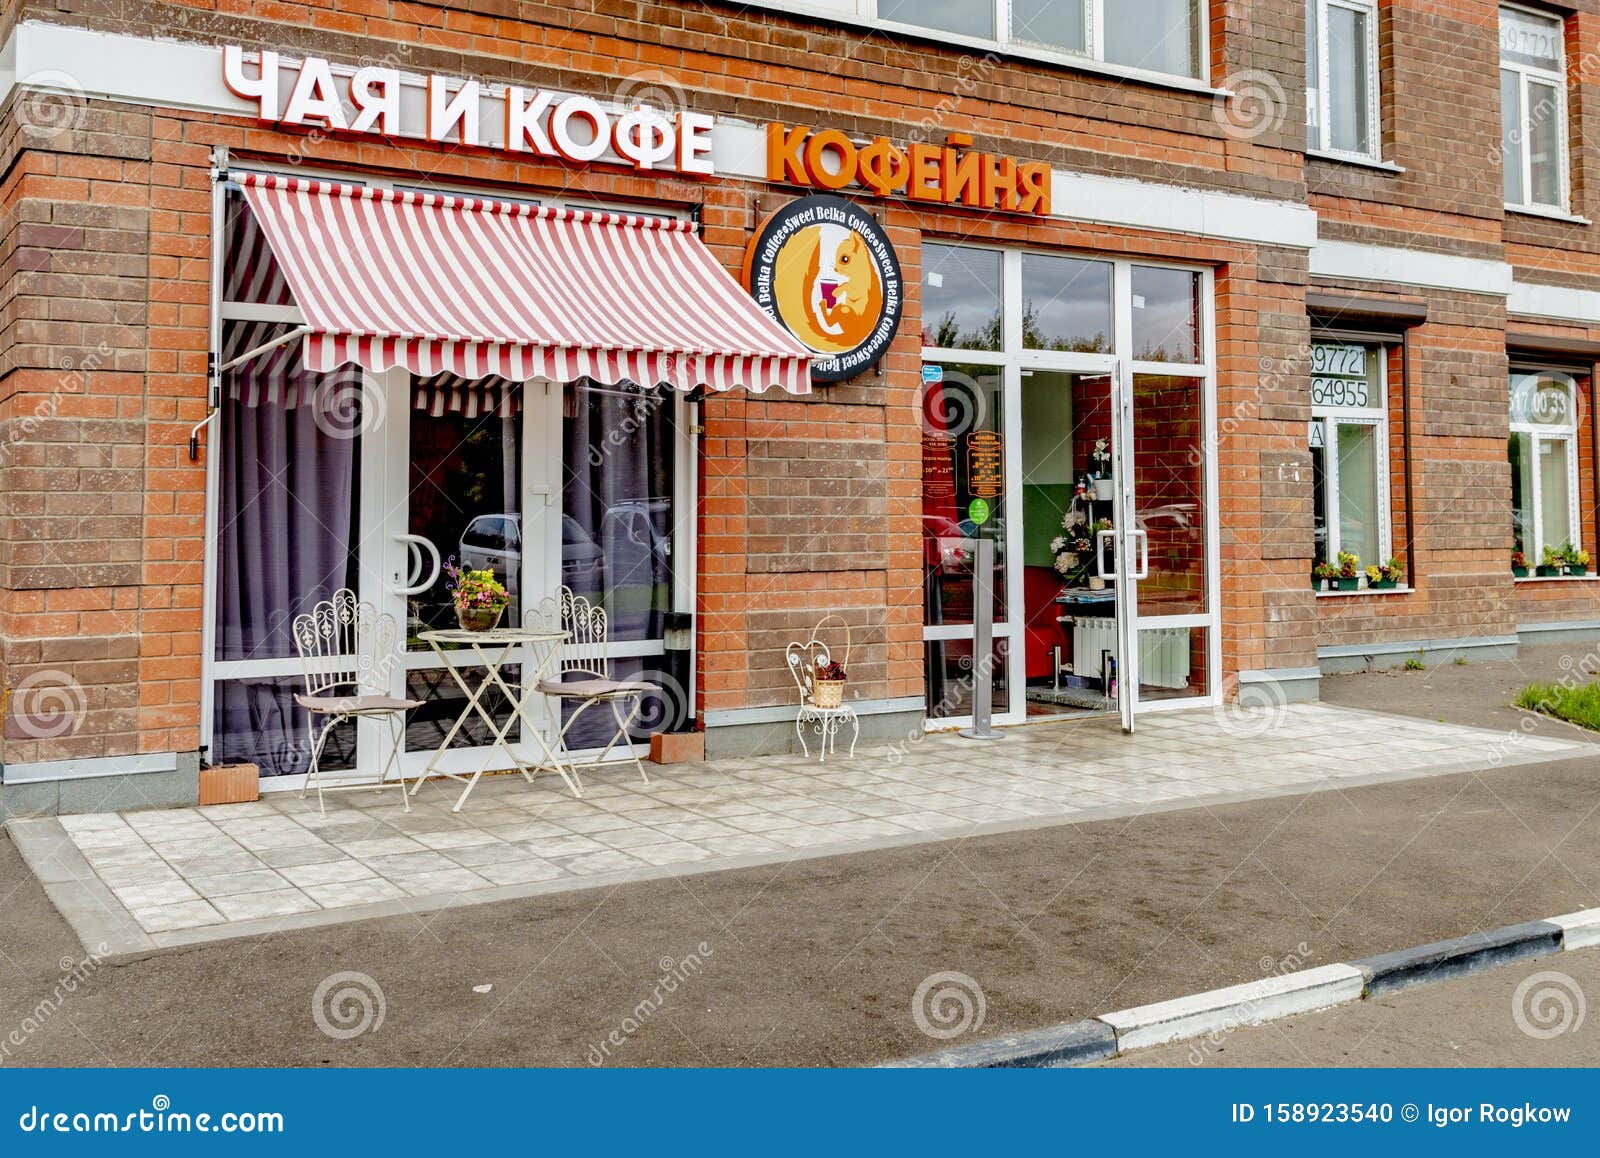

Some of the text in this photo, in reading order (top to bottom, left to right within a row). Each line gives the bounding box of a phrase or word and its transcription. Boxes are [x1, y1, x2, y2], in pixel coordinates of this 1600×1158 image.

[222, 45, 714, 175] ЧАЯ И КОФЕ
[766, 122, 1052, 216] КОФЕЙНЯ
[785, 210, 815, 232] Sweet
[815, 206, 846, 223] Belka
[848, 214, 875, 243] Coffee
[761, 228, 786, 264] Coffee
[874, 243, 895, 278] Sweet
[757, 266, 771, 303] Belka
[885, 280, 898, 315] Belka
[870, 316, 894, 349] Coffee
[812, 359, 841, 372] Bel
[842, 346, 871, 371] Sweet
[1312, 378, 1367, 407] 64955
